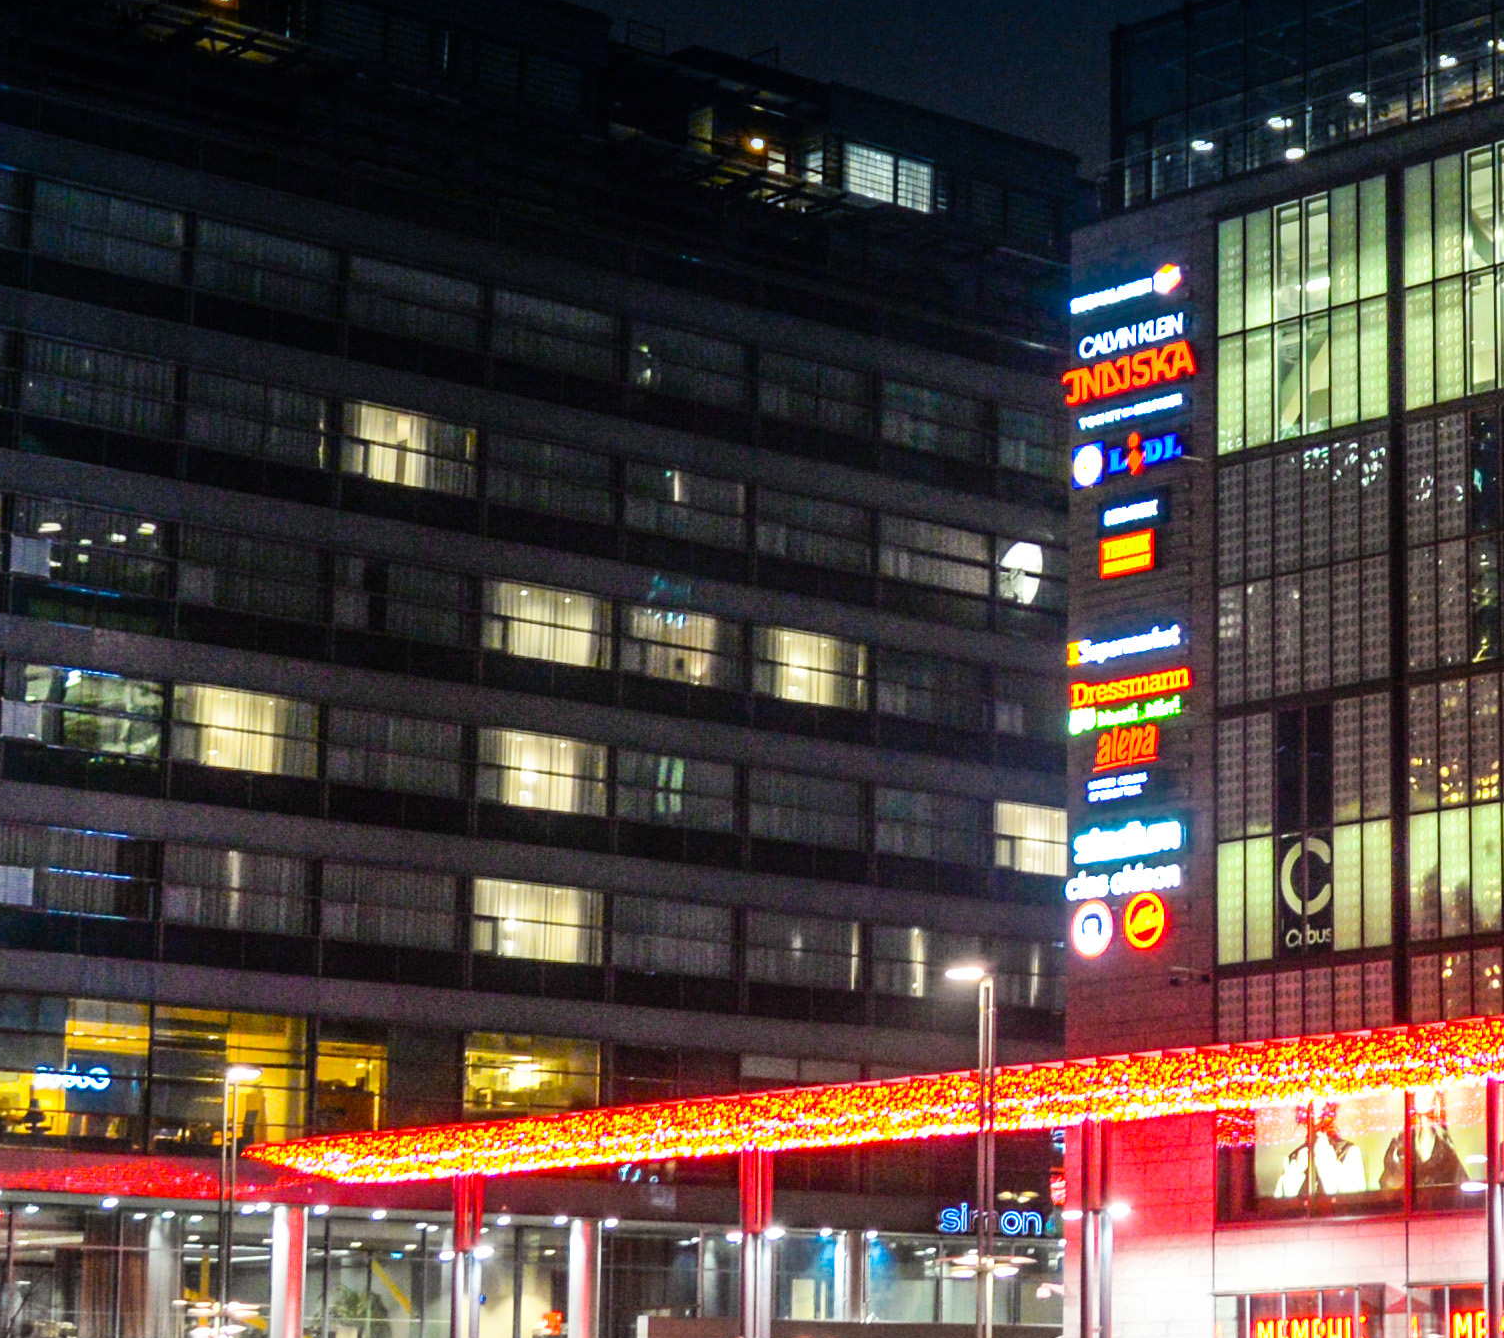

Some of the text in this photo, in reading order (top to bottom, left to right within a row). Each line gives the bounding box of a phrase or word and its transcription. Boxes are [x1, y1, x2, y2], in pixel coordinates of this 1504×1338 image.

[1078, 311, 1185, 360] CALVIN KLEIN
[1071, 667, 1192, 709] Dressmann
[1096, 724, 1159, 766] alepa
